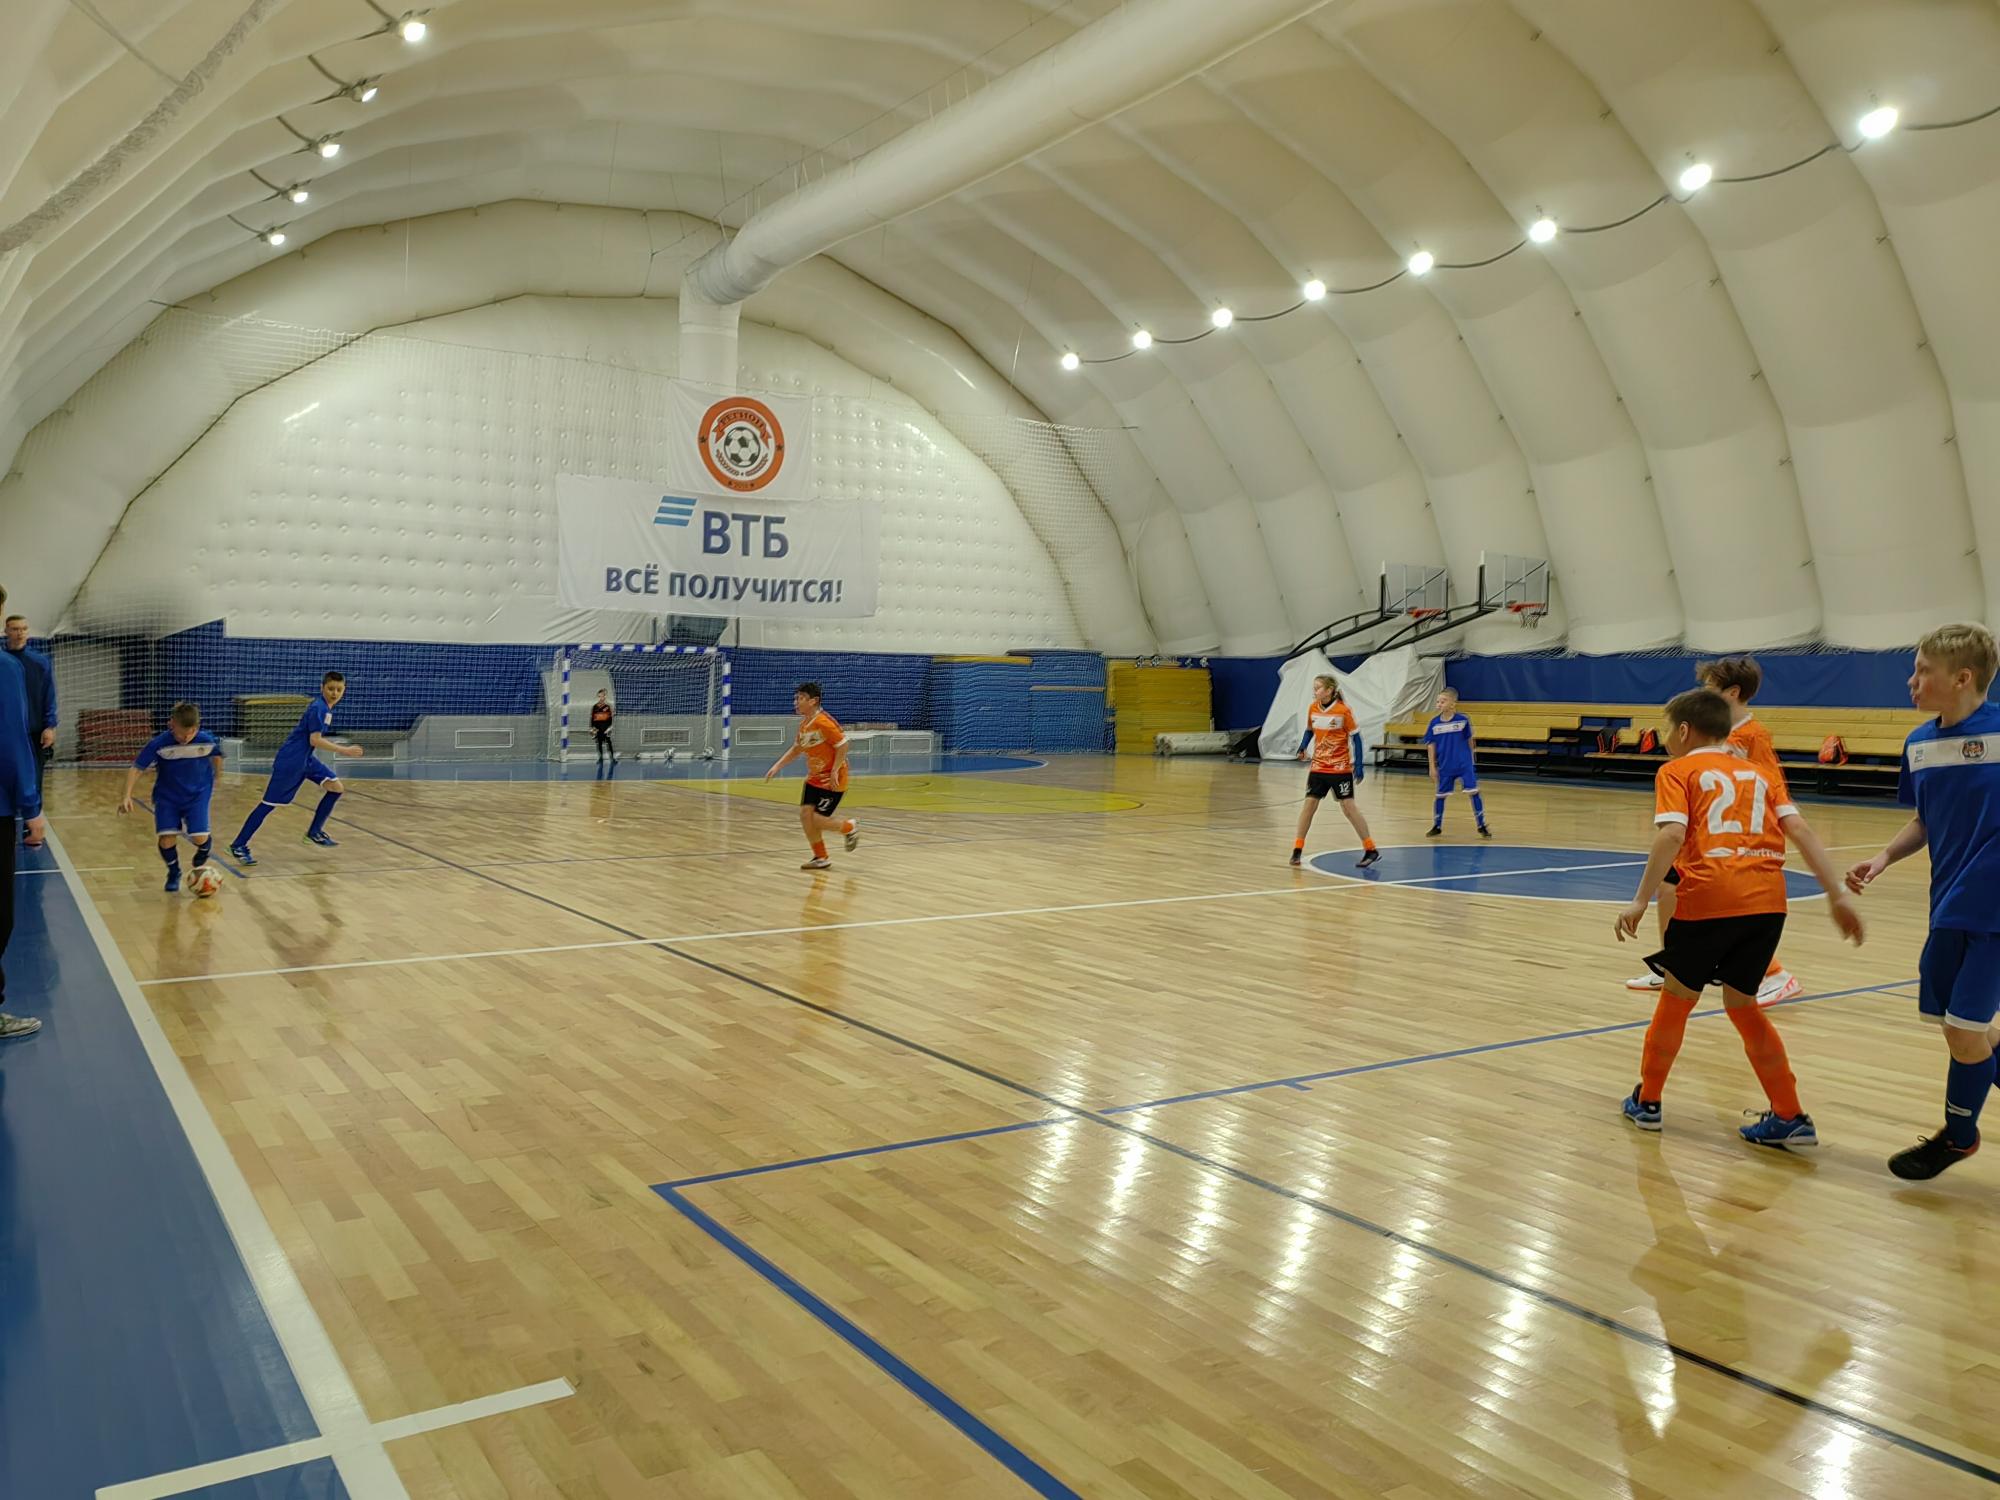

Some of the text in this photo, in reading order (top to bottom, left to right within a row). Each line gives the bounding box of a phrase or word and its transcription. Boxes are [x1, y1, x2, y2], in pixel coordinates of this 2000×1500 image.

[703, 510, 789, 558] ВТБ
[605, 562, 843, 603] ВСЁ ПОЛУЧИТСЯ!
[1699, 769, 1769, 834] 27
